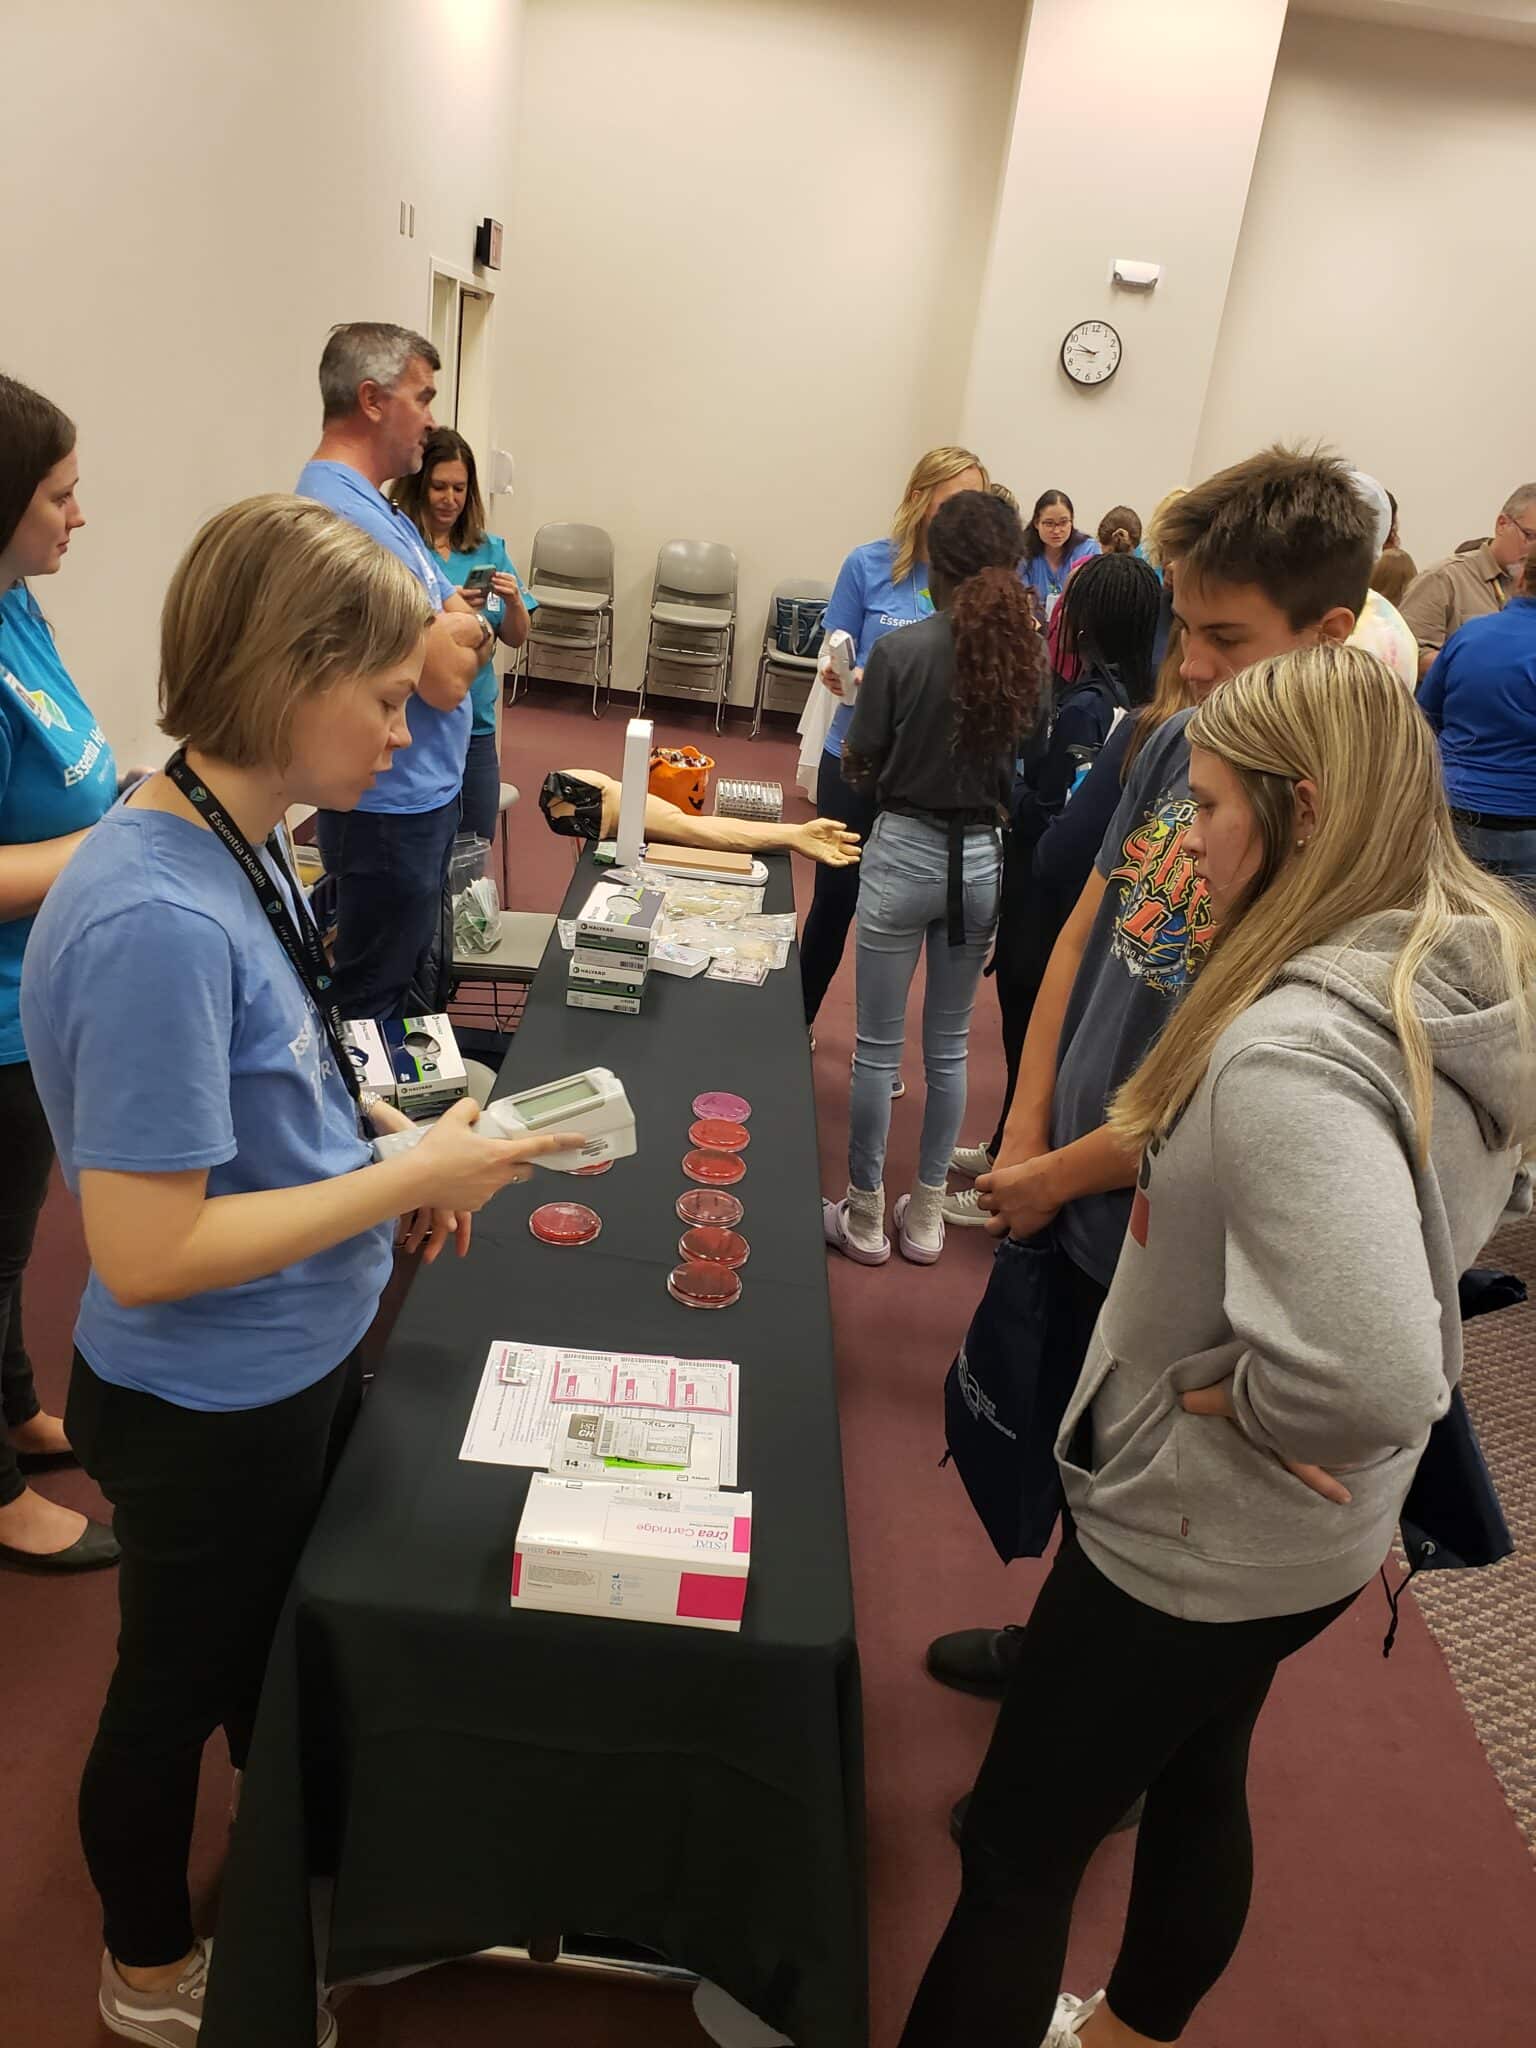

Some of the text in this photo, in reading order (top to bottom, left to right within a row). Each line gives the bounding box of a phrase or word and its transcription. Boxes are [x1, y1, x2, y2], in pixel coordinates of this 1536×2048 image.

[1081, 327, 1088, 335] 11
[1092, 325, 1101, 333] 12
[1071, 334, 1079, 343] 10
[1110, 339, 1116, 348] 2
[1068, 358, 1074, 366] 8
[1106, 363, 1111, 371] 4
[1075, 368, 1081, 377] 7
[1096, 371, 1103, 379] 5
[1085, 373, 1090, 381] 6
[208, 811, 267, 888] Essentia Health
[565, 1459, 579, 1467] 14
[657, 1492, 672, 1500] 14
[636, 1522, 695, 1537] Cartridge
[698, 1529, 729, 1541] Crea
